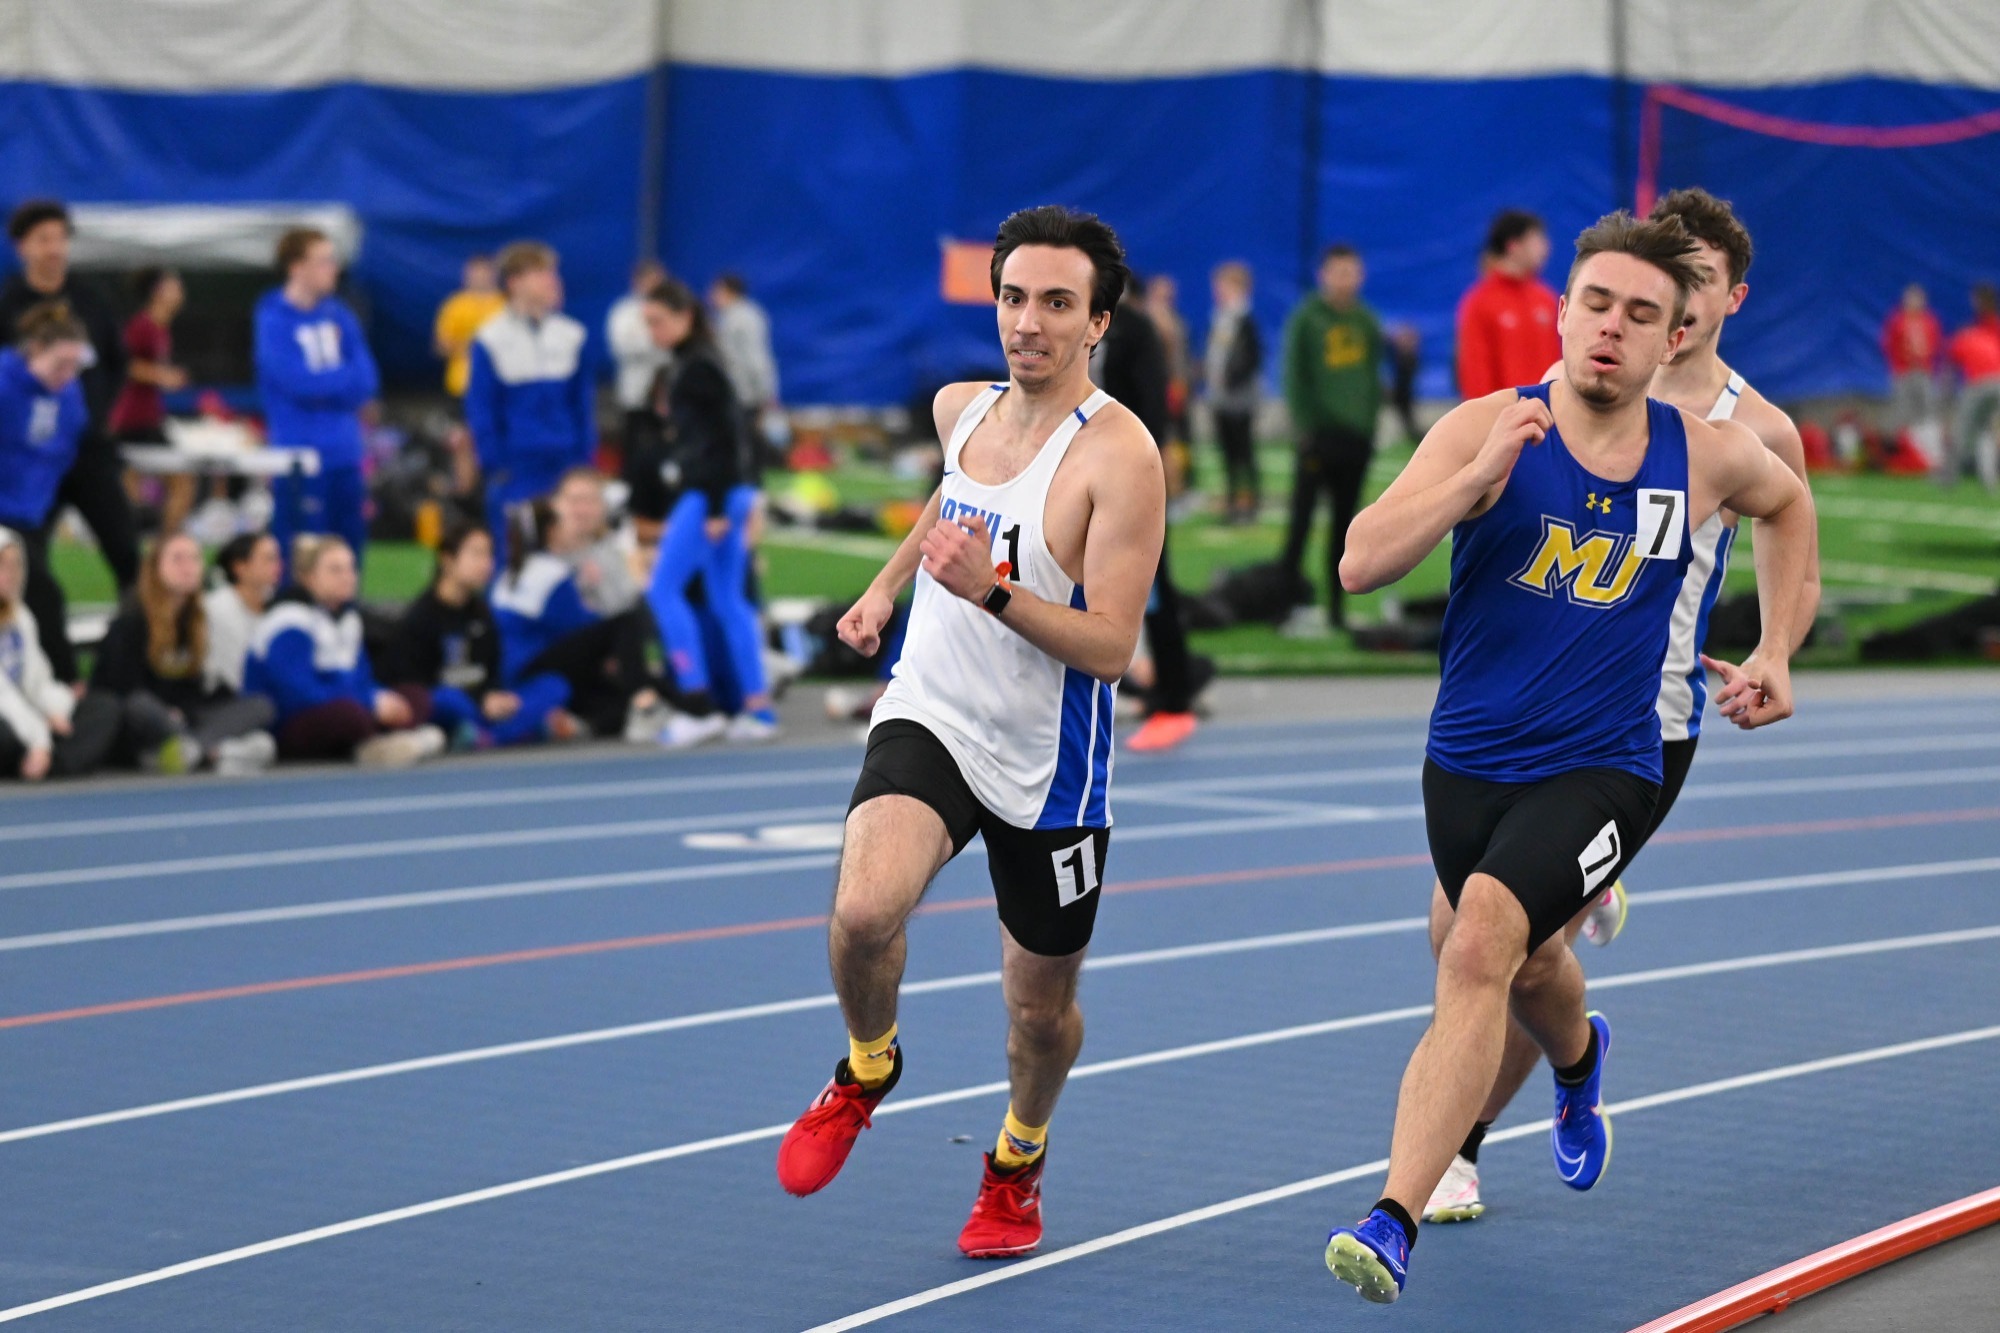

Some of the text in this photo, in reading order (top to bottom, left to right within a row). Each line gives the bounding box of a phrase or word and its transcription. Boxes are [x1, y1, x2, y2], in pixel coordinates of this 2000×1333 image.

[1002, 524, 1021, 581] 1
[1649, 494, 1676, 556] 7
[1508, 514, 1650, 609] MU
[1061, 846, 1086, 896] 1
[1584, 832, 1618, 876] 7
